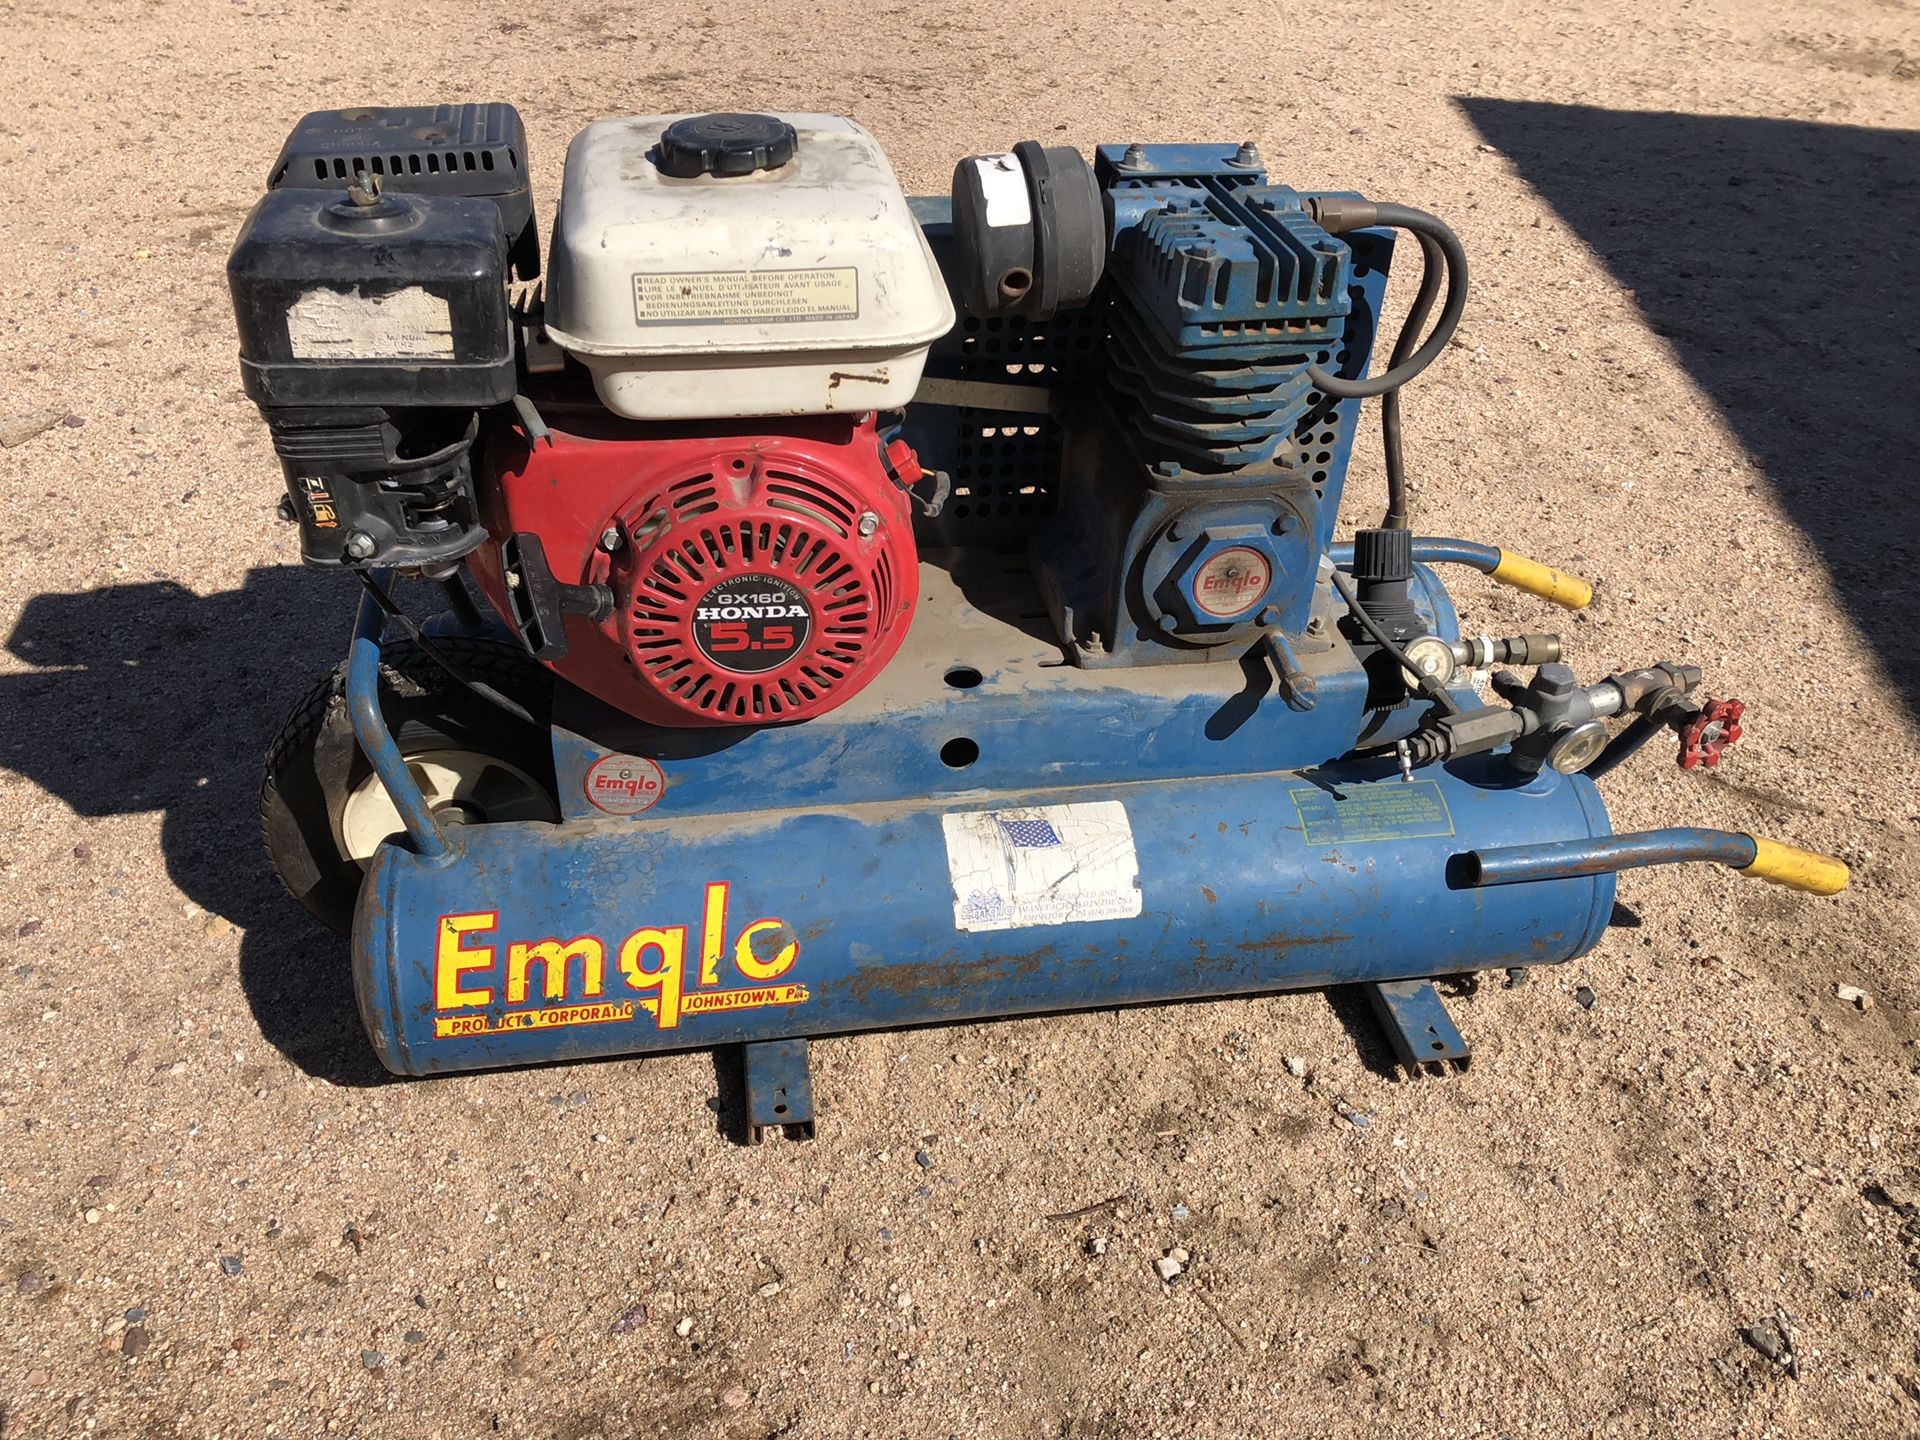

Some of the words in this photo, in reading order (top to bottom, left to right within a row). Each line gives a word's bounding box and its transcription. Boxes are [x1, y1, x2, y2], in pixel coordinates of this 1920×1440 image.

[644, 277, 667, 285] READ
[670, 276, 710, 284] OWNER'S
[752, 274, 785, 282] BEFORE
[784, 281, 810, 289] AVANT
[645, 293, 663, 301] VOR
[745, 290, 794, 298] UNBEDINGT
[646, 299, 749, 309] BEDIENUNGSANLEITUNG
[660, 309, 696, 317] UTILIZAR
[740, 307, 753, 315] NO
[754, 306, 781, 314] HABER
[782, 305, 806, 313] LEIDO
[808, 305, 817, 313] EL
[703, 575, 759, 602] ELECTRONIC
[763, 577, 801, 600] IGNITION
[717, 593, 786, 605] GX160
[697, 605, 809, 620] HONDA
[710, 622, 794, 651] 5.5
[685, 990, 780, 1010] JOHNSTOWN,
